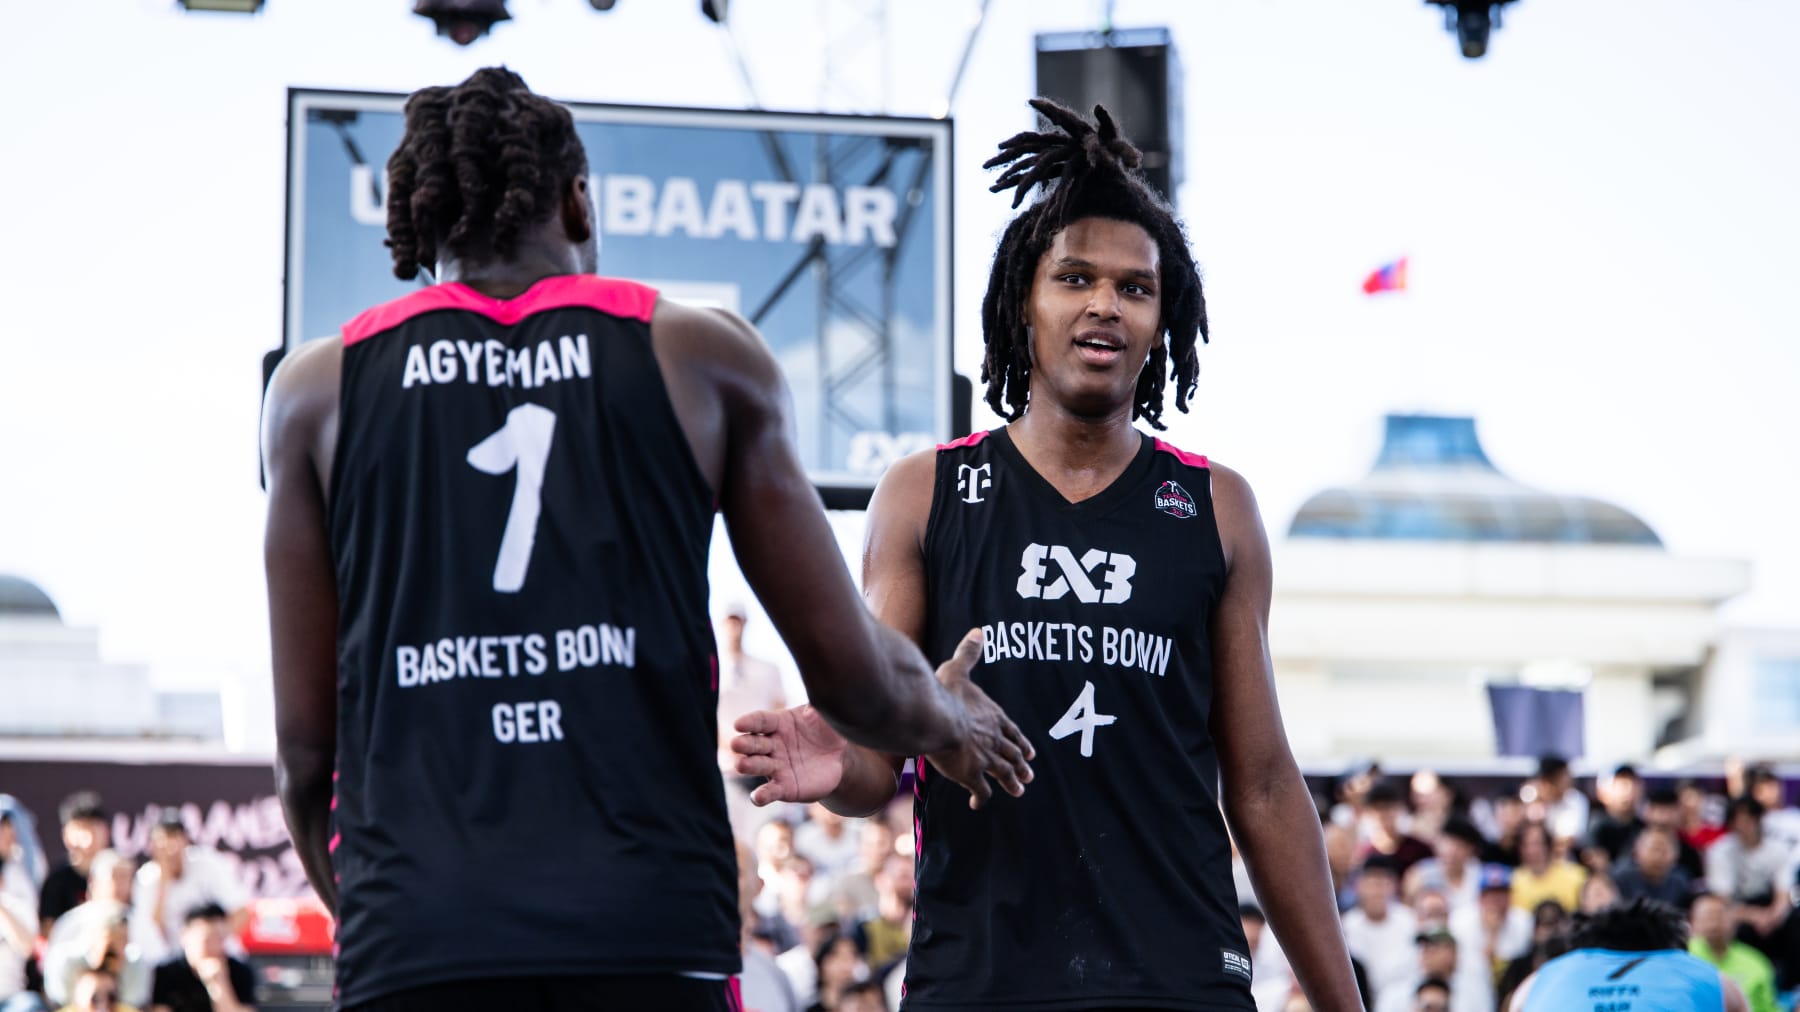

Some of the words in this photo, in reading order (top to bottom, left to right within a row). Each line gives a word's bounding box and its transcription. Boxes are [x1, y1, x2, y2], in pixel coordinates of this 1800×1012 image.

[350, 165, 898, 247] UBAATAR
[402, 334, 591, 389] AGYEMAN
[466, 402, 557, 594] 1
[1157, 497, 1194, 514] BASKETS
[396, 633, 548, 687] BASKETS
[555, 622, 636, 672] BONN
[982, 621, 1094, 664] BASKETS
[1102, 626, 1173, 677] BONN
[491, 699, 564, 743] GER
[1049, 680, 1118, 758] 4
